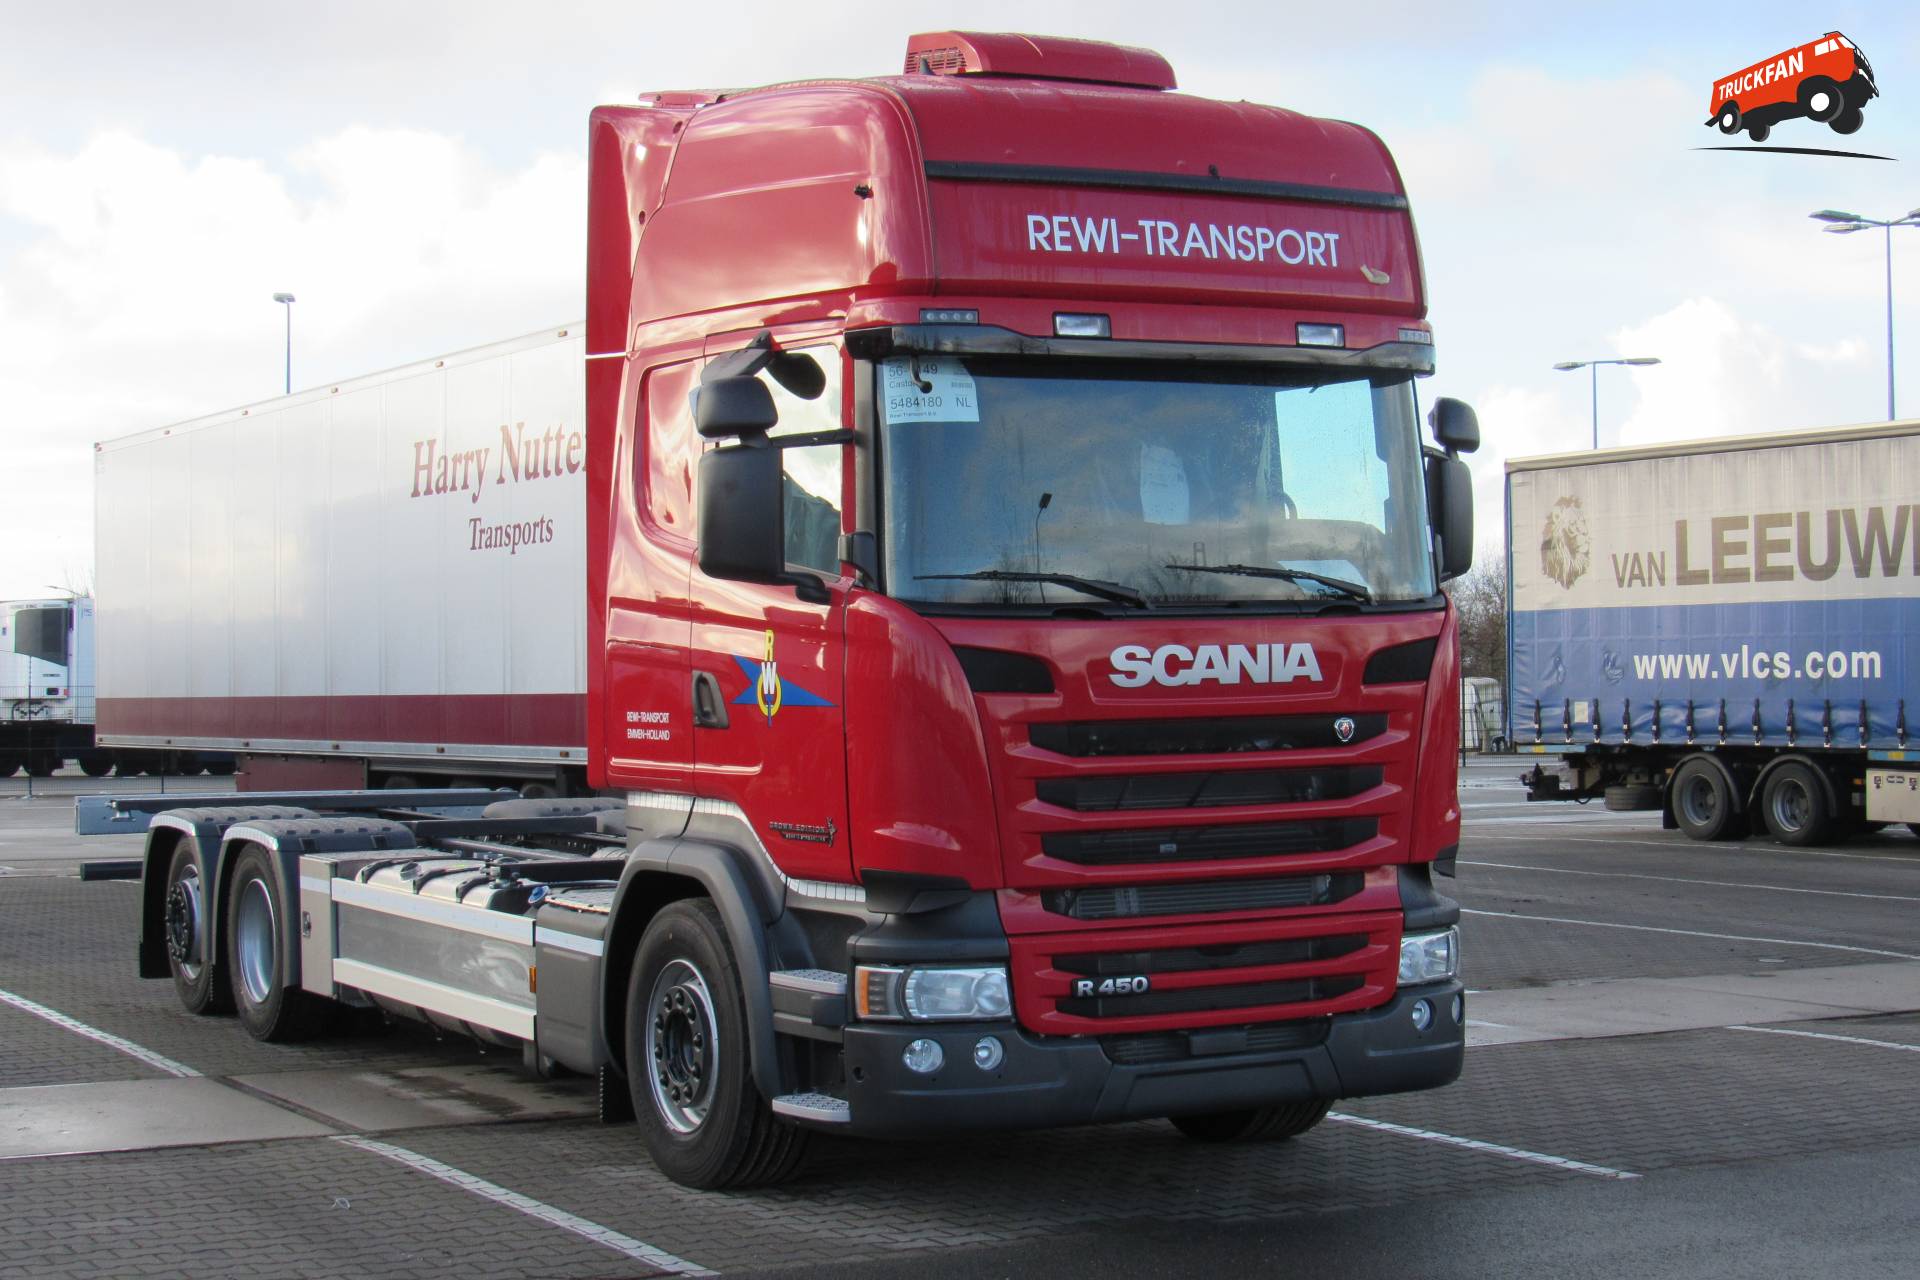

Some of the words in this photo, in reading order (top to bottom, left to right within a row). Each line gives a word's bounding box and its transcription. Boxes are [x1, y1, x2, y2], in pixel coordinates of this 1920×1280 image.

[1027, 214, 1340, 267] REWI-TRANSPORT
[890, 397, 943, 409] 5484180
[955, 397, 973, 408] NL
[411, 438, 490, 504] Harry
[496, 421, 587, 485] Nutte
[469, 514, 553, 555] Transports
[1612, 551, 1666, 588] VAN
[1108, 643, 1323, 688] SCANIA
[1633, 644, 1881, 679] www.vlcs.com
[626, 711, 670, 723] REWI-TRANSPORT
[1077, 980, 1094, 997] R
[1098, 976, 1149, 994] 450
